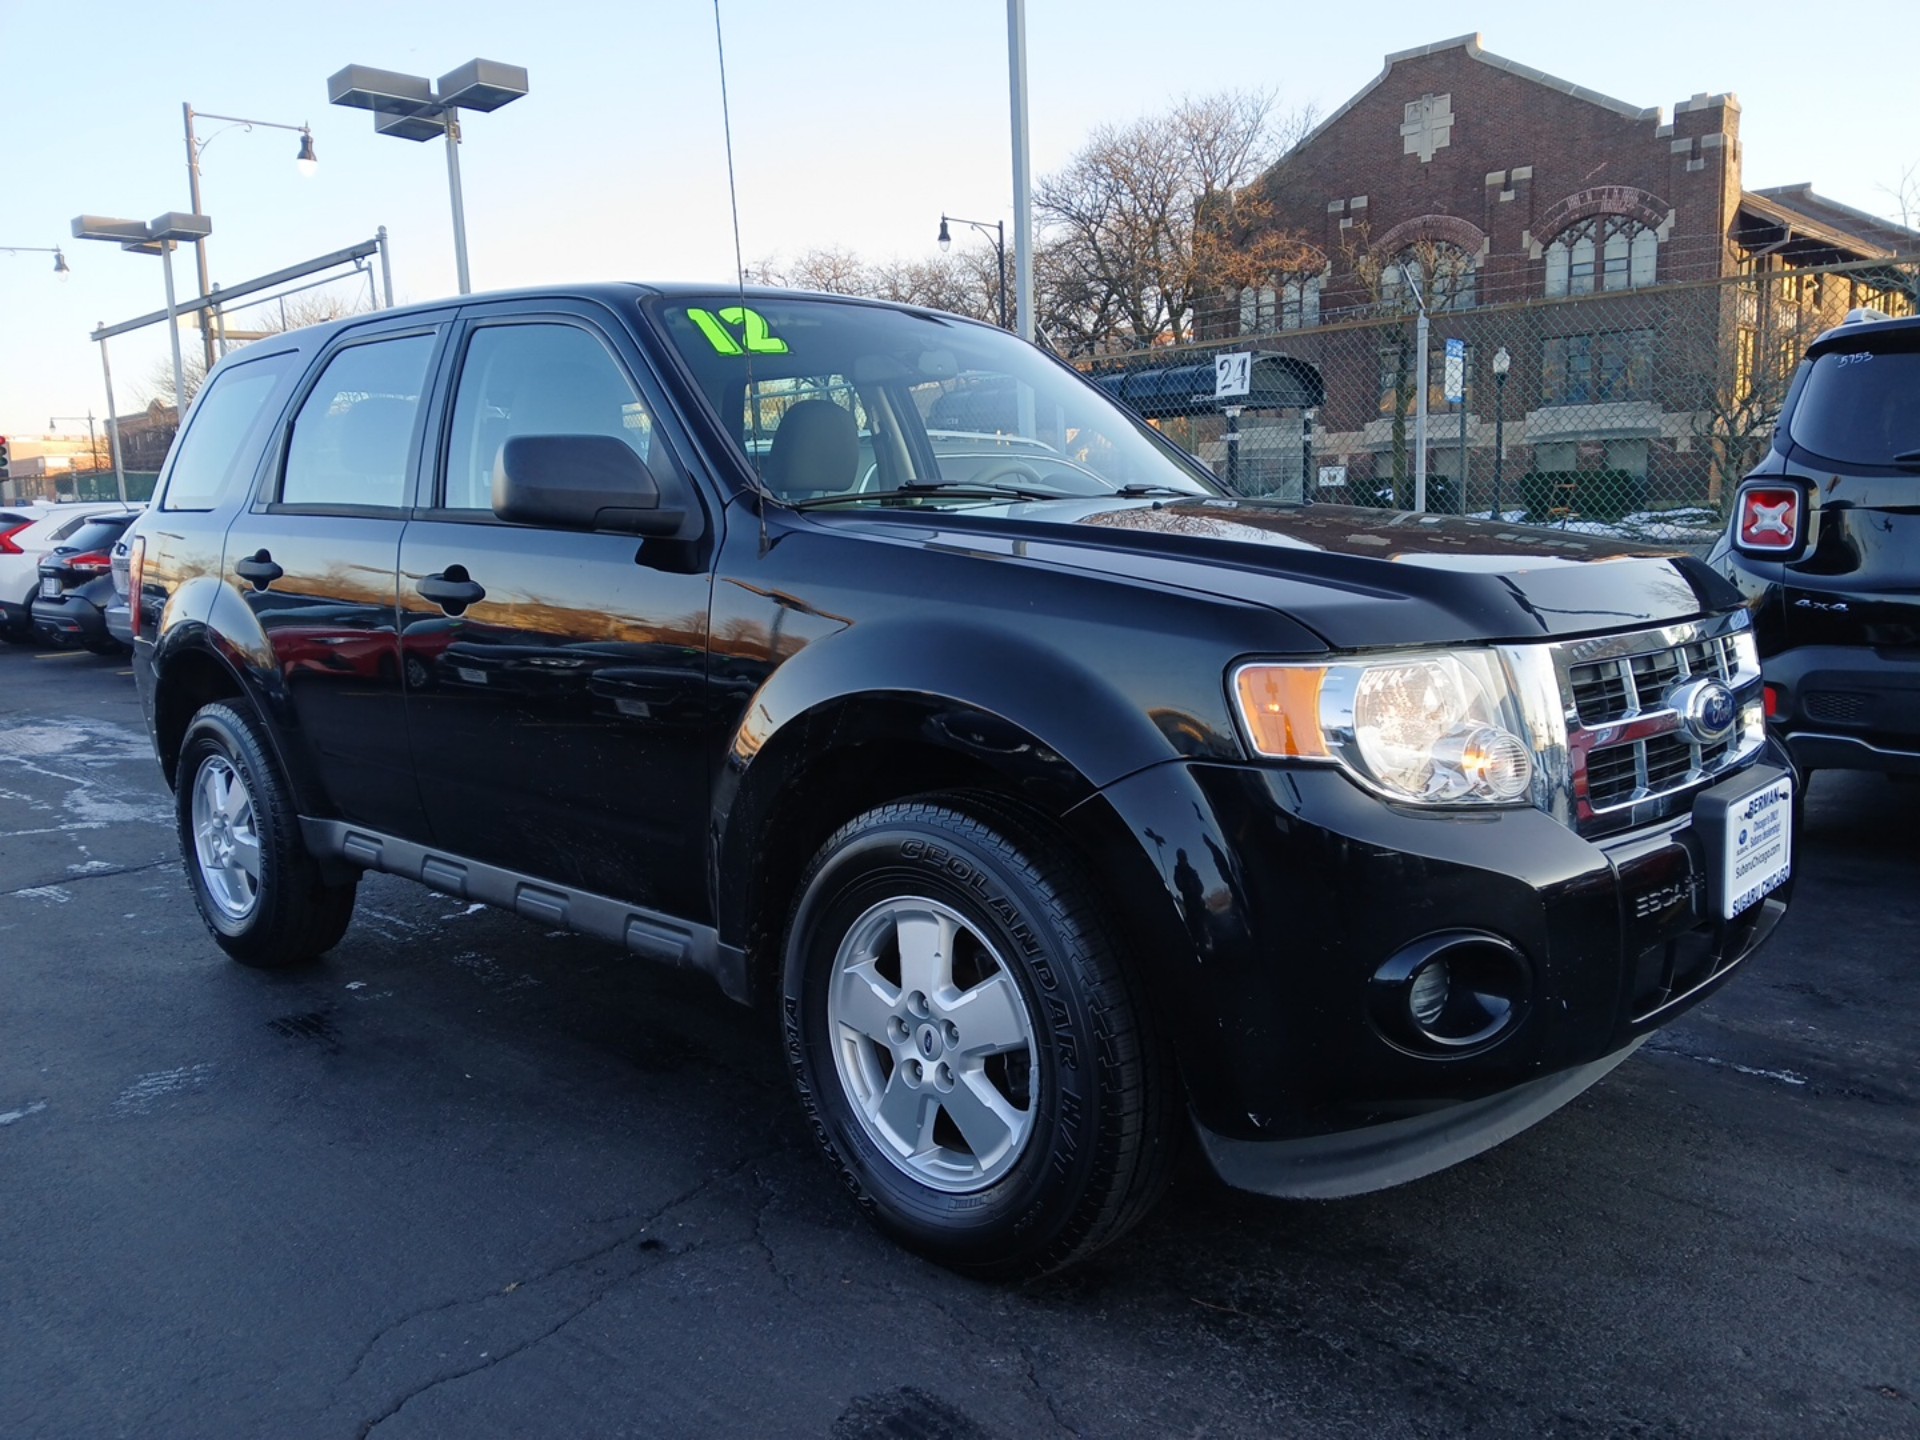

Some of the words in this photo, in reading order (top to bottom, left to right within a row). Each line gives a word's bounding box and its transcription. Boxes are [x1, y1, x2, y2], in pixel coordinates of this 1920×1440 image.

[687, 307, 788, 354] 12
[1219, 357, 1247, 390] 24
[1795, 599, 1850, 612] 4x4
[1749, 787, 1780, 815] BERMAN
[1735, 843, 1781, 880] SubaruChicago.com
[1732, 886, 1761, 917] SUBARU
[1761, 865, 1790, 897] CHICAGO
[900, 838, 1079, 1071] GEOLANDAR
[785, 995, 878, 1218] YOKOHAMA
